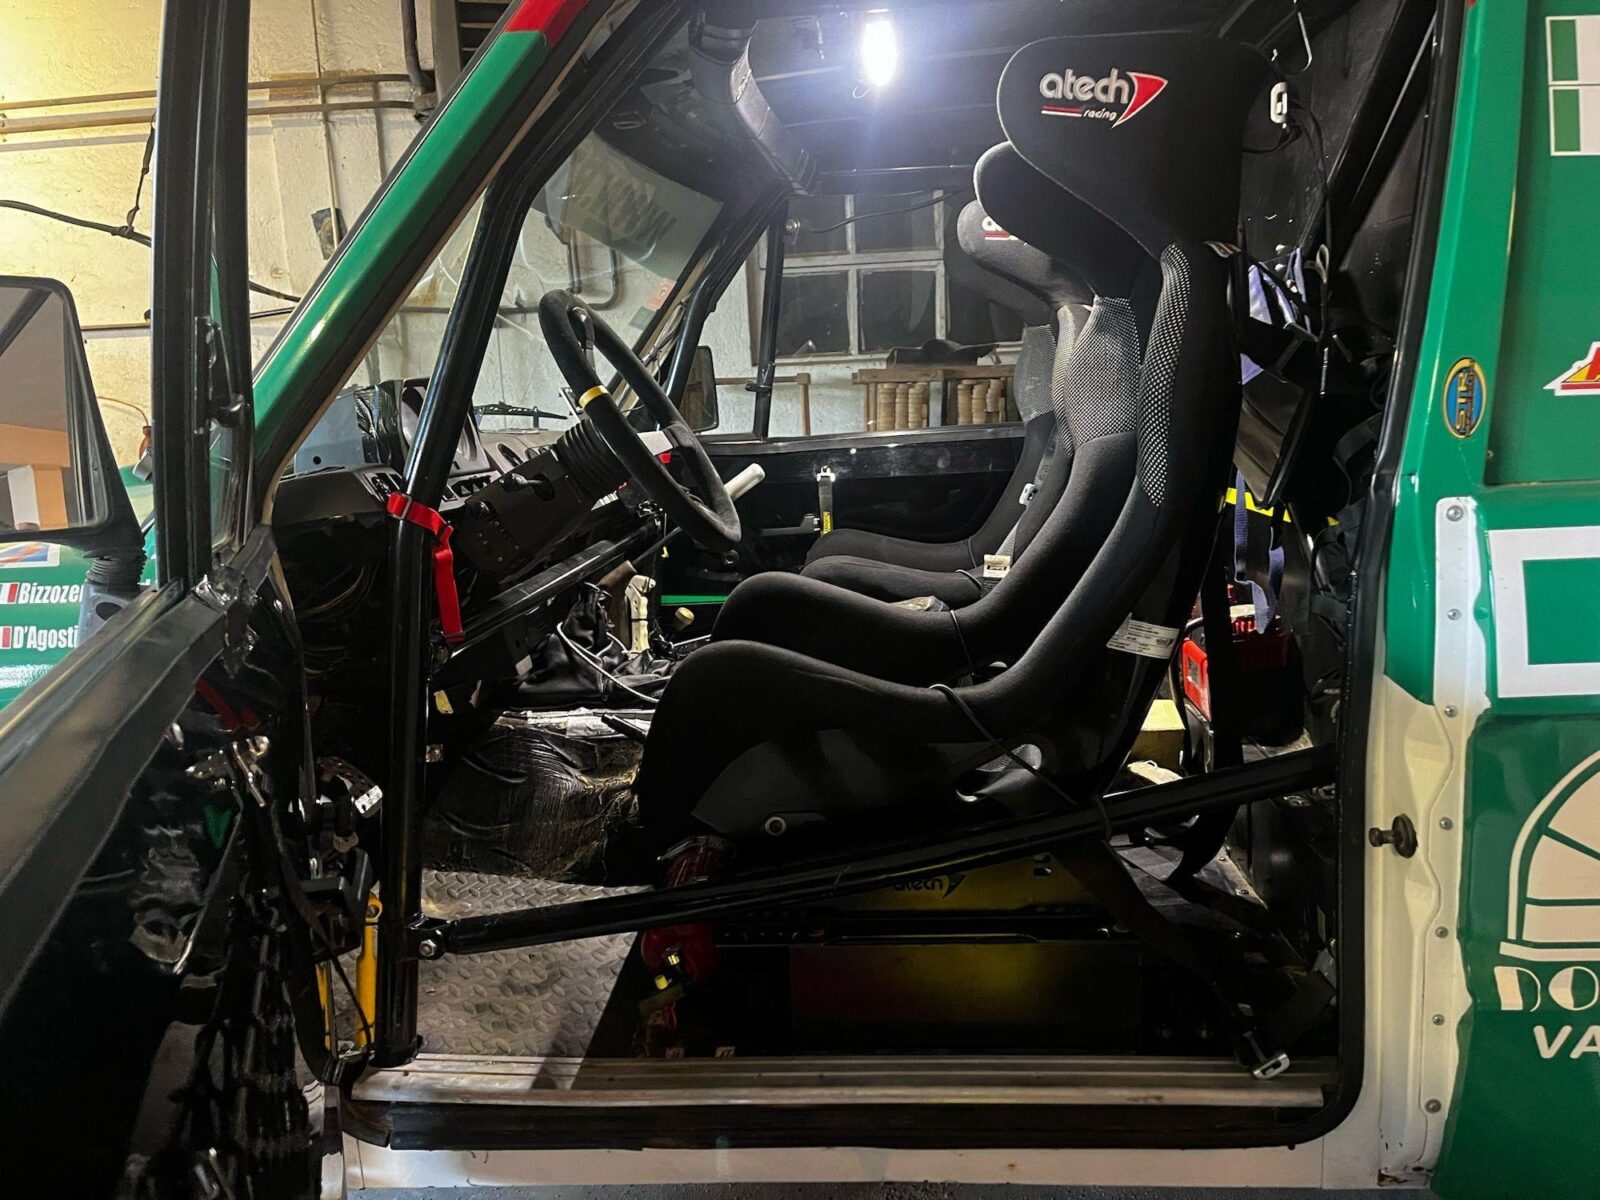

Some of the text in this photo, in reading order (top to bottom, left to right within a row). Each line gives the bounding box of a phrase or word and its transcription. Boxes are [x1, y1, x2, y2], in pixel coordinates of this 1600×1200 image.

[1040, 68, 1129, 104] atech
[1083, 108, 1117, 121] racing
[13, 625, 79, 652] D'Agosti
[1533, 1025, 1600, 1059] VA
